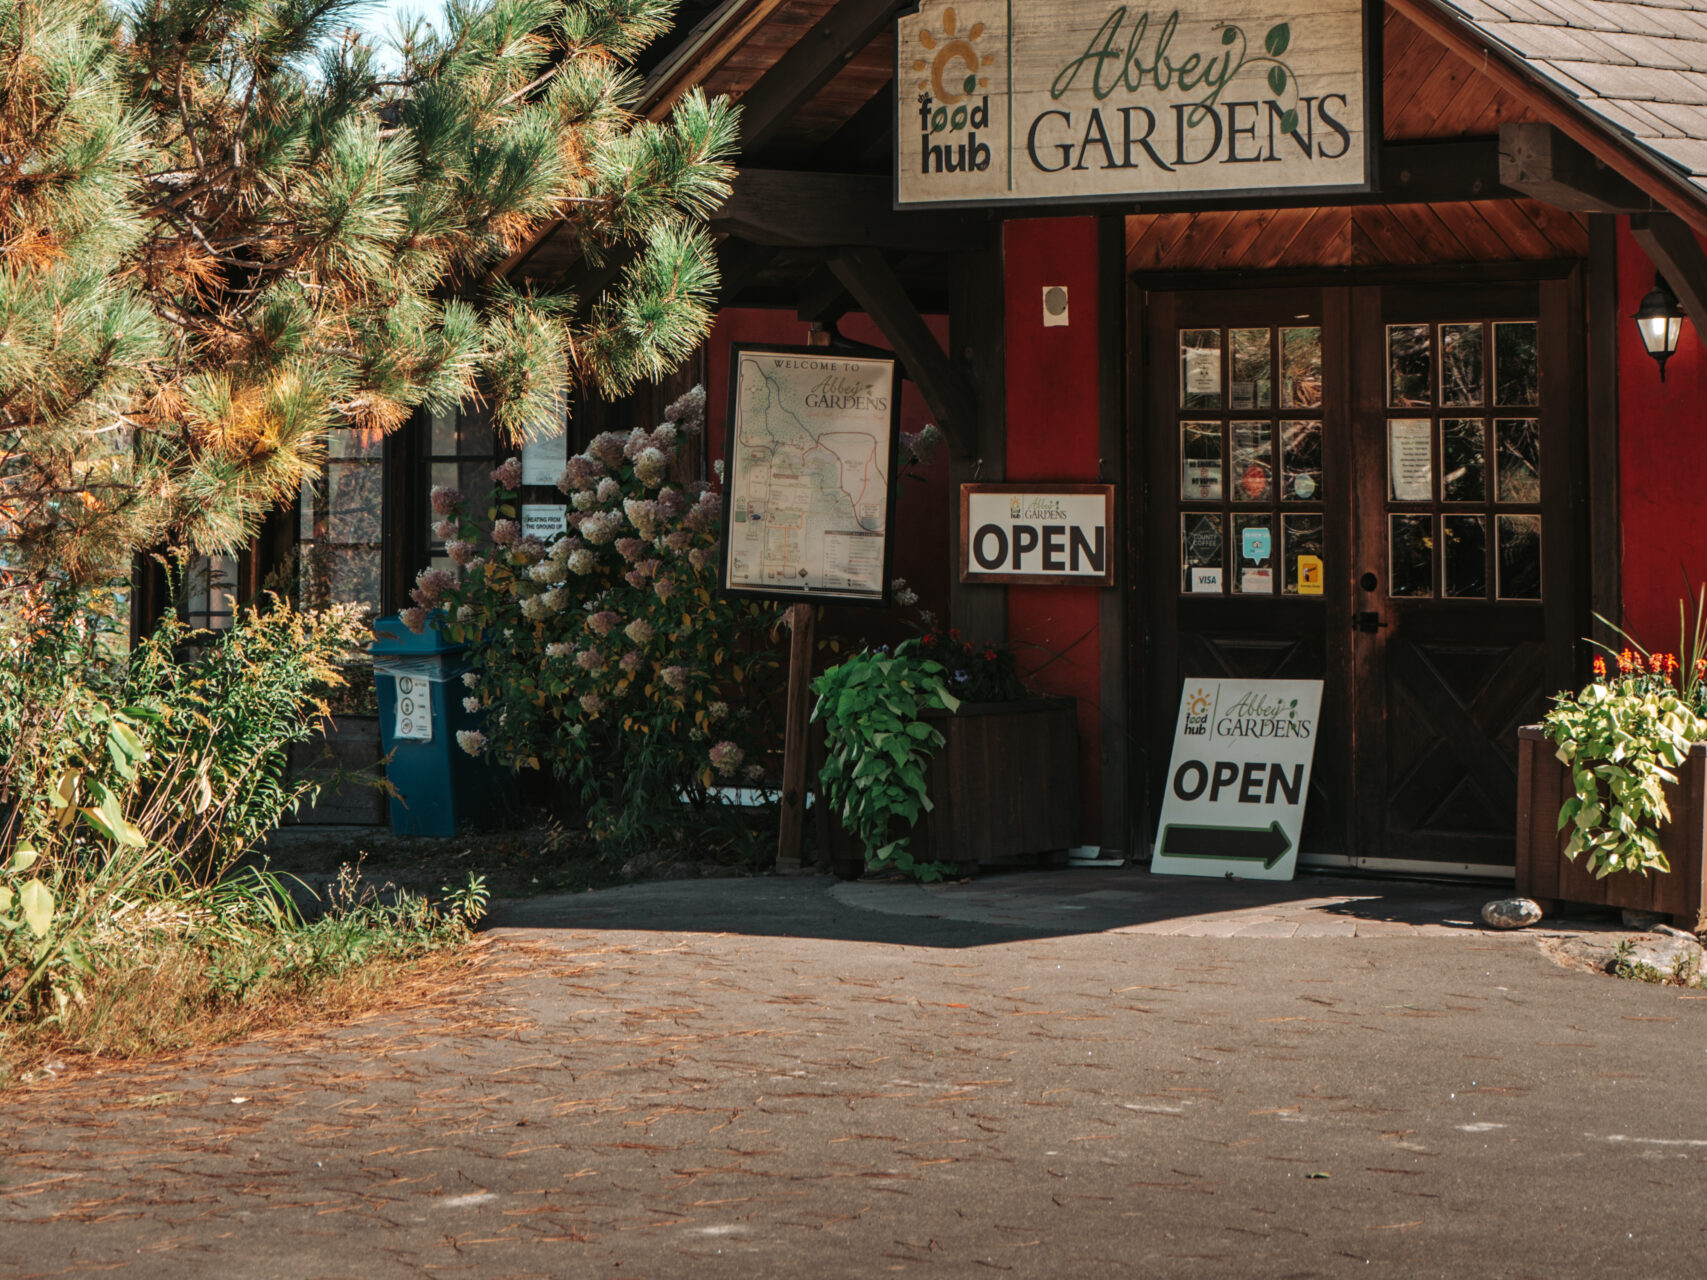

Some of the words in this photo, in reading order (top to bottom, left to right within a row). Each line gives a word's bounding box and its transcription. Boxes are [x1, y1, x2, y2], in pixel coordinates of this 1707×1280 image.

[1050, 4, 1241, 128] Abbey
[919, 96, 989, 135] food
[1027, 93, 1352, 174] GARDENS
[921, 131, 992, 174] hub
[774, 359, 837, 372] WELCOME
[844, 363, 860, 373] TO
[810, 374, 861, 397] Abbey
[805, 393, 888, 412] GARDENS
[1024, 509, 1067, 520] GARDENS
[973, 523, 1105, 572] OPEN
[1199, 575, 1217, 585] VISA
[1185, 713, 1208, 724] food
[1226, 691, 1280, 726] Abbey
[1184, 723, 1206, 736] hub
[1216, 717, 1312, 739] GARDENS
[1173, 759, 1305, 805] OPEN
